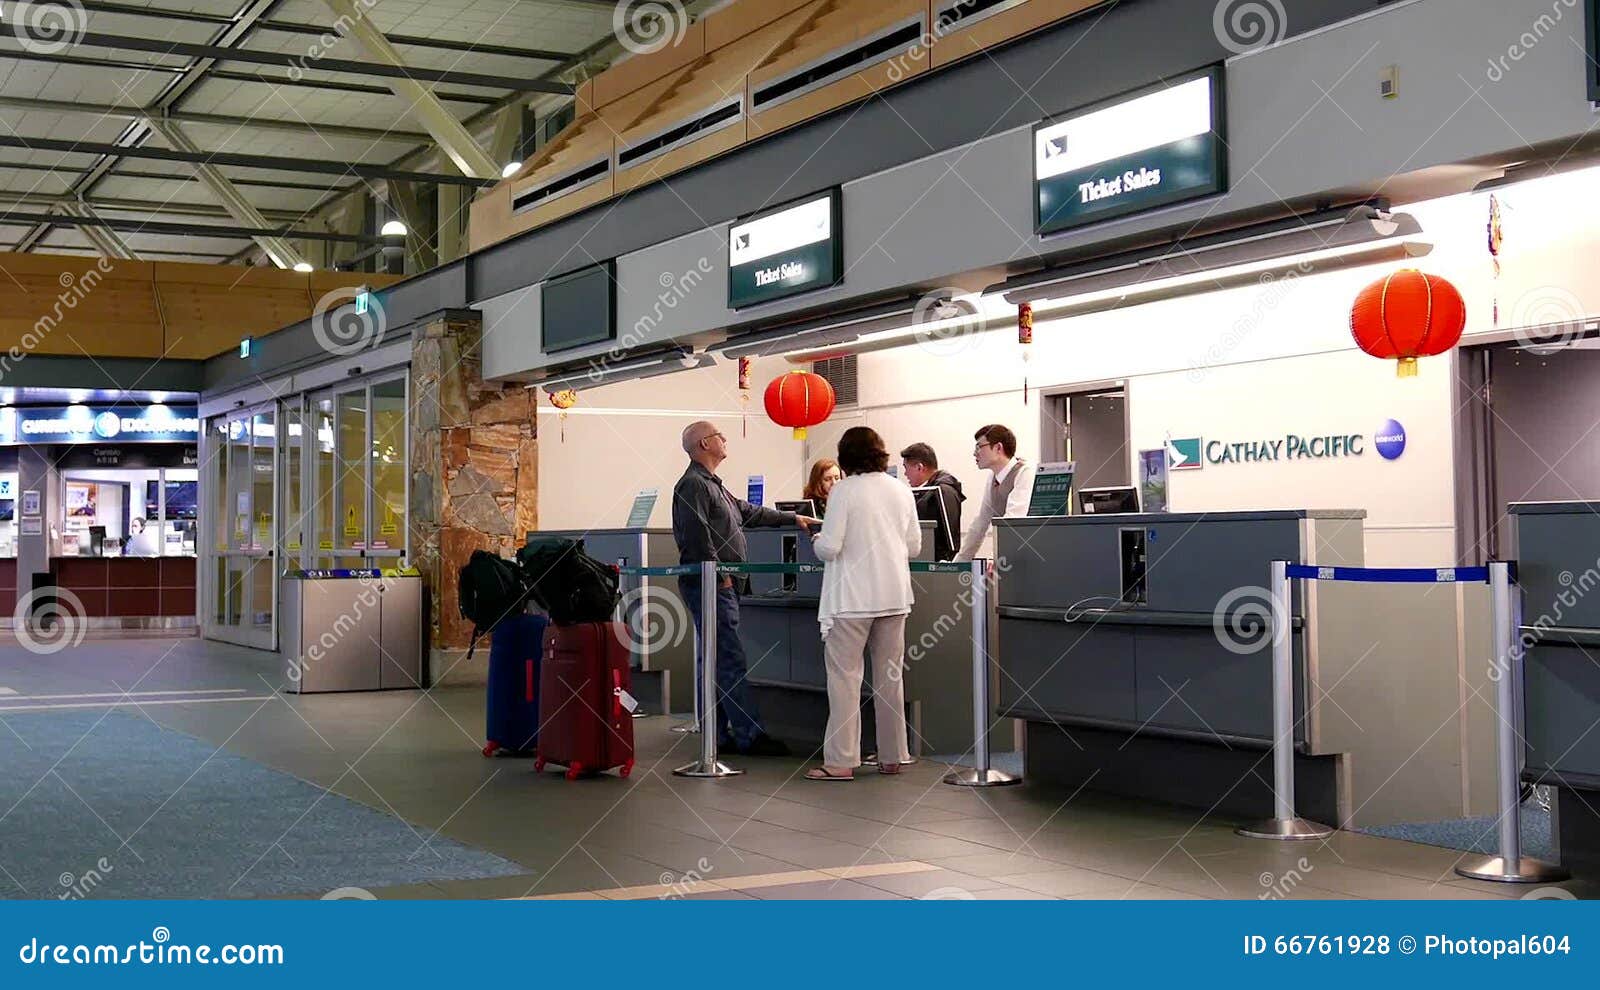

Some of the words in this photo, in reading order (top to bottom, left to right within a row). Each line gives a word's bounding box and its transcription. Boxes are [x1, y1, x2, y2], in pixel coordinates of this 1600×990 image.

[1079, 176, 1122, 203] Ticket
[1123, 167, 1161, 192] Sales
[754, 267, 780, 287] Ticket
[781, 261, 802, 280] Sales
[1206, 440, 1283, 464] CATHAY
[1286, 434, 1364, 460] PACIFIC
